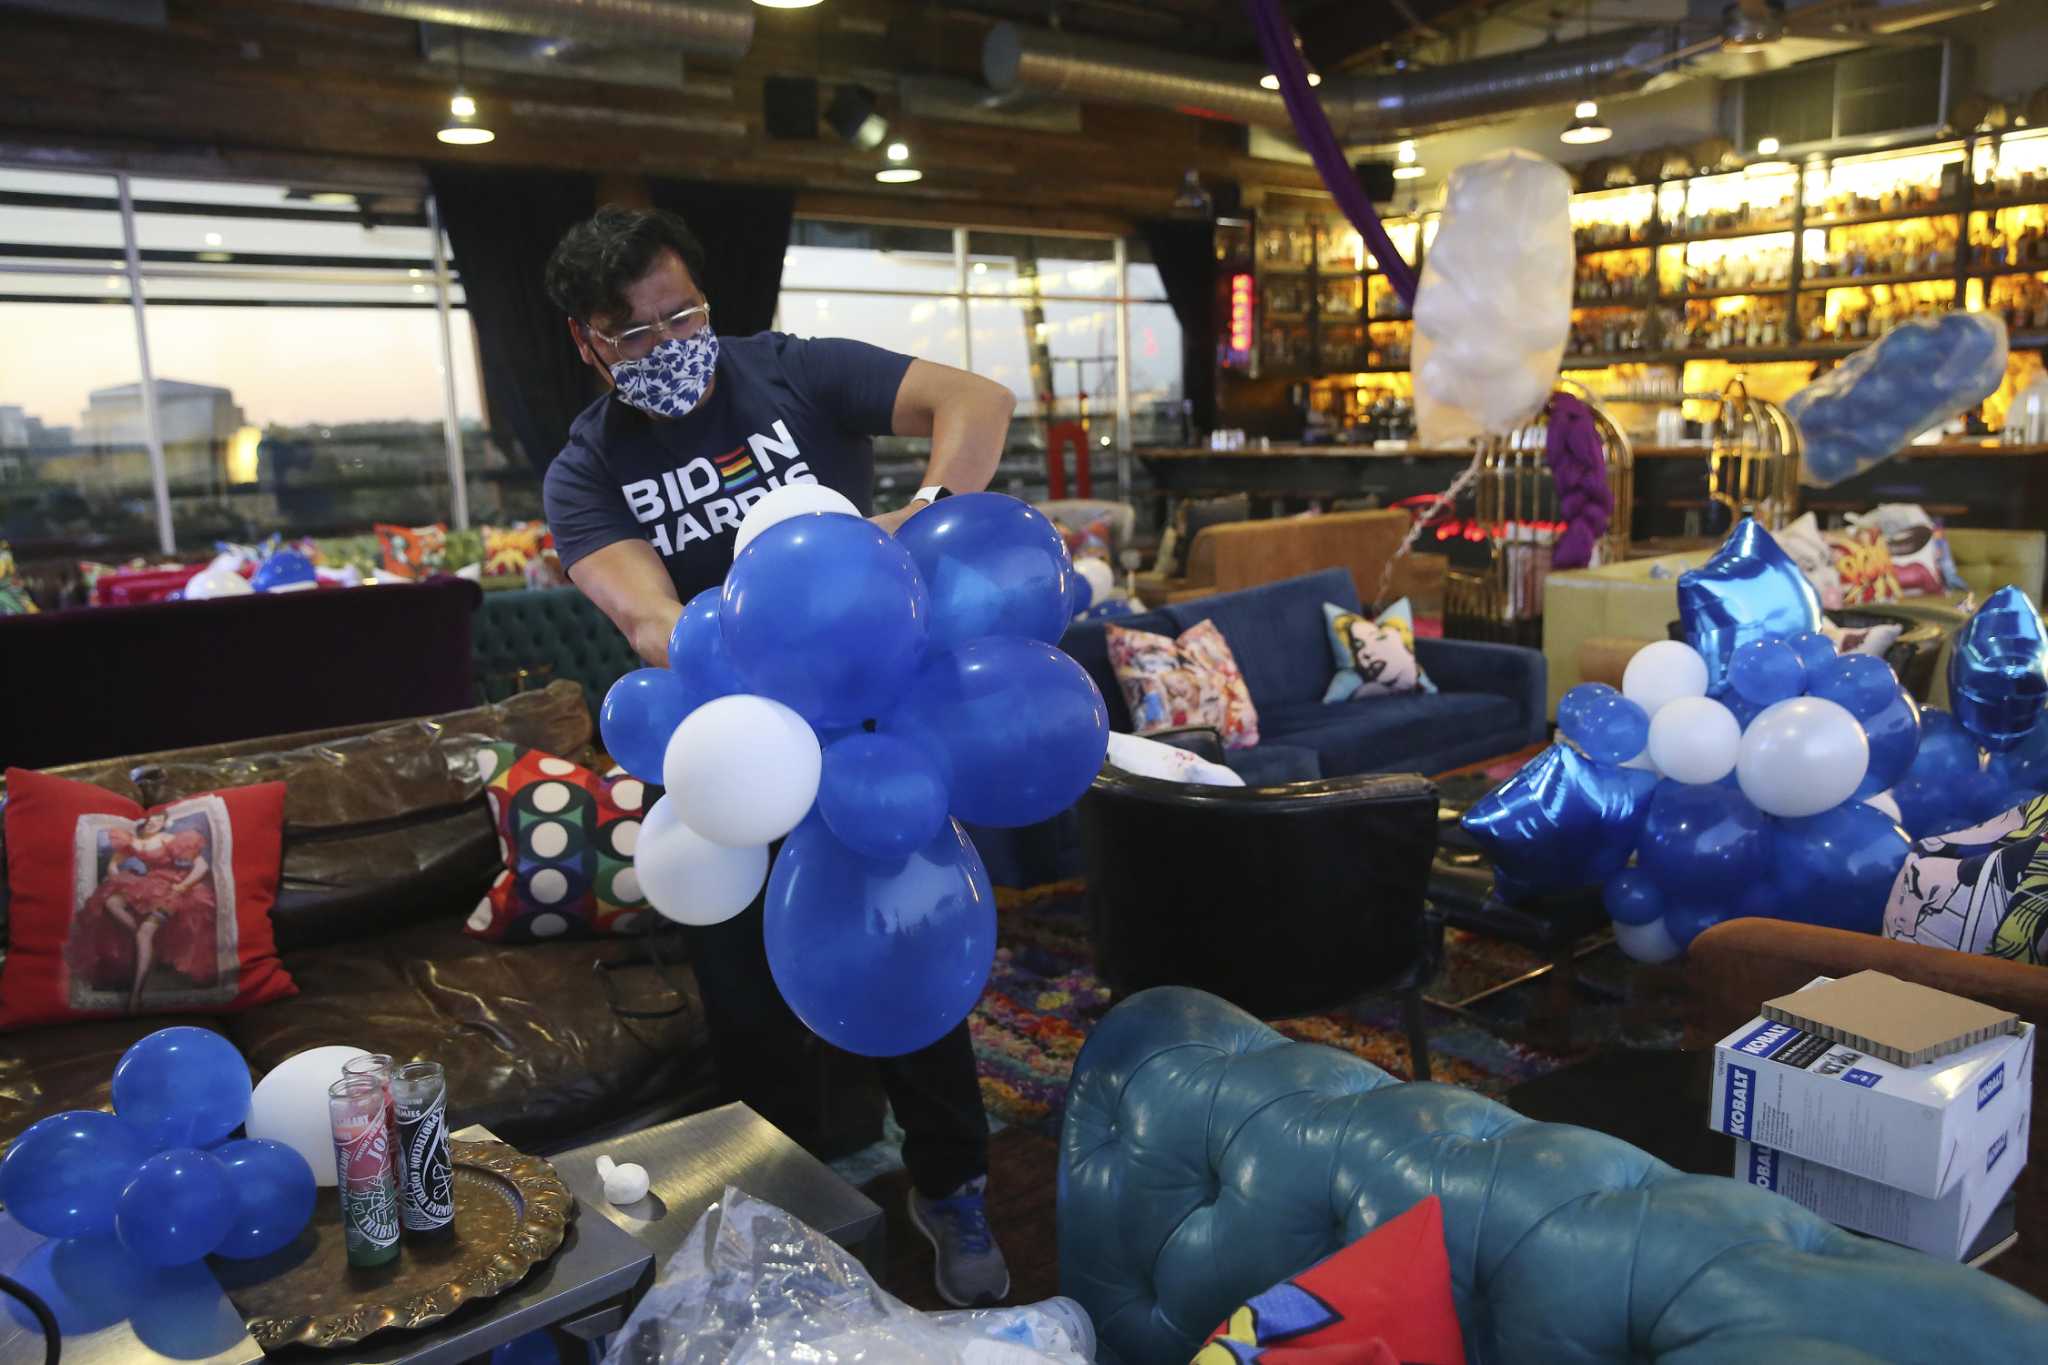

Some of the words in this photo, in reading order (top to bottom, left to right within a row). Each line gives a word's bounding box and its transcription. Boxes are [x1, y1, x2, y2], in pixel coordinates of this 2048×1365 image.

[621, 418, 800, 523] BIDEN
[1730, 1068, 1749, 1136] KOBALT
[1756, 1146, 1773, 1189] OBAL
